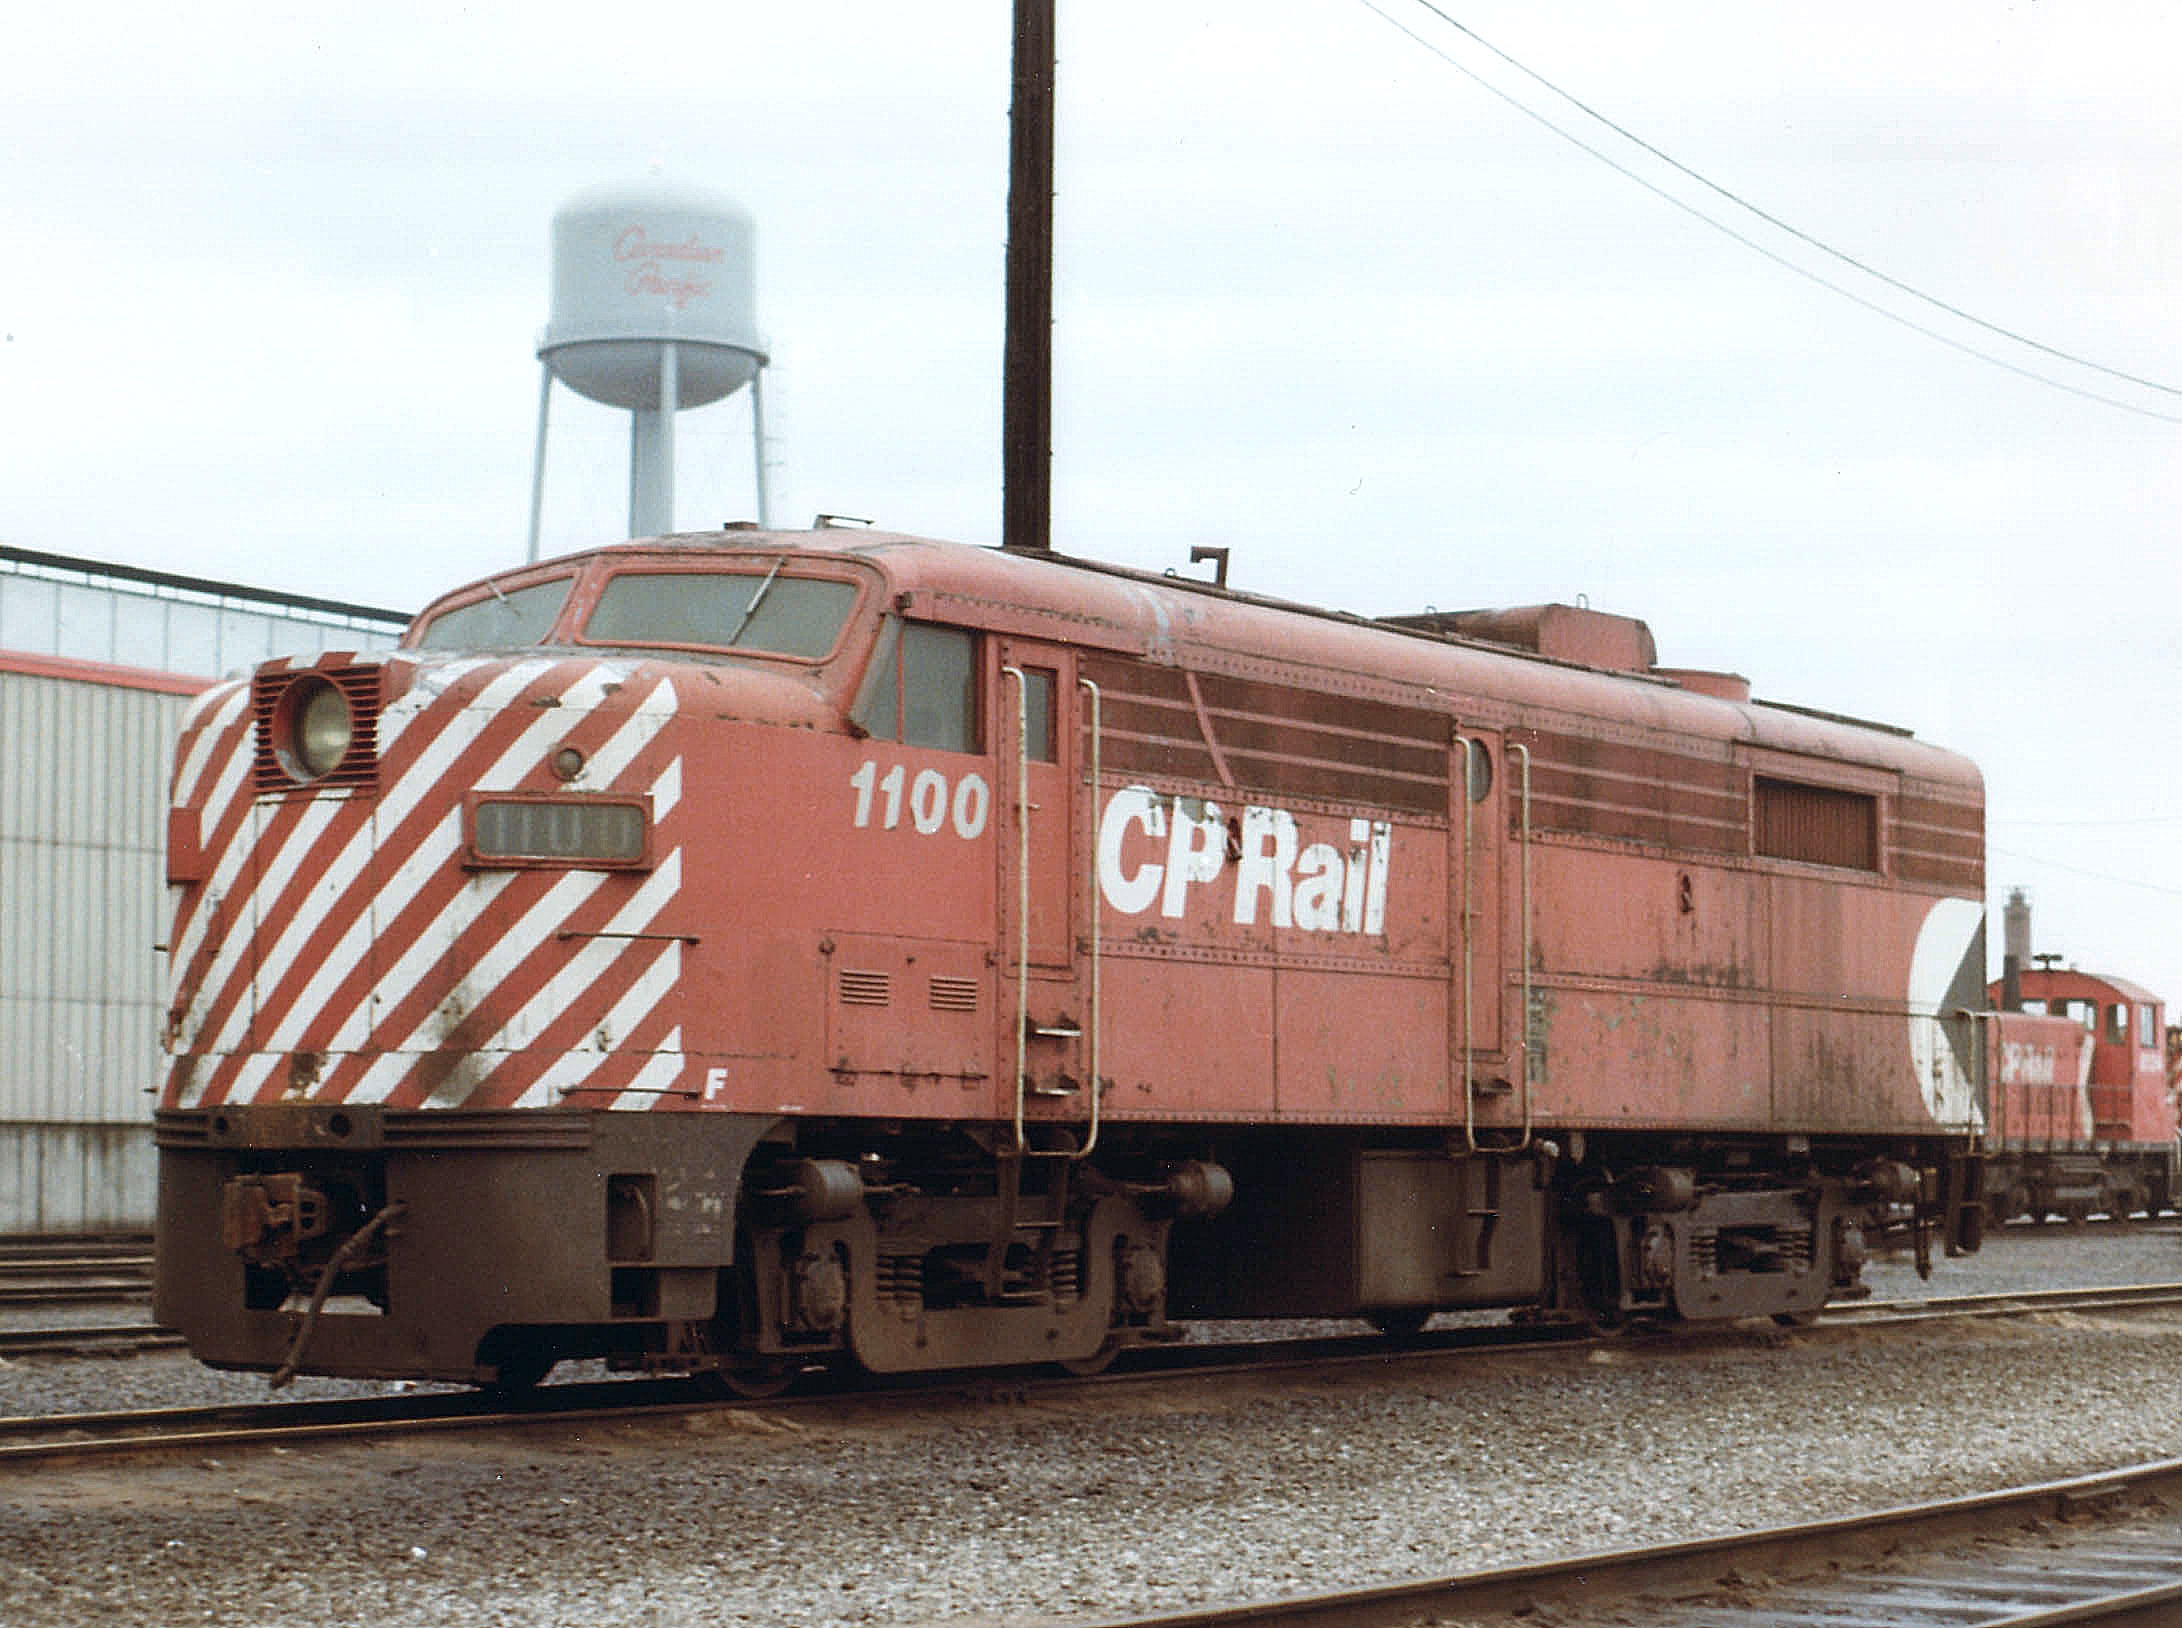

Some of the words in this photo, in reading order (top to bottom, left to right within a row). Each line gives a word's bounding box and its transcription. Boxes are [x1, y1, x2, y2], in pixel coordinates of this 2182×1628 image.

[851, 761, 989, 839] 1100
[1100, 785, 1226, 918] CP
[1233, 805, 1392, 936] Rail
[704, 1067, 729, 1100] F
